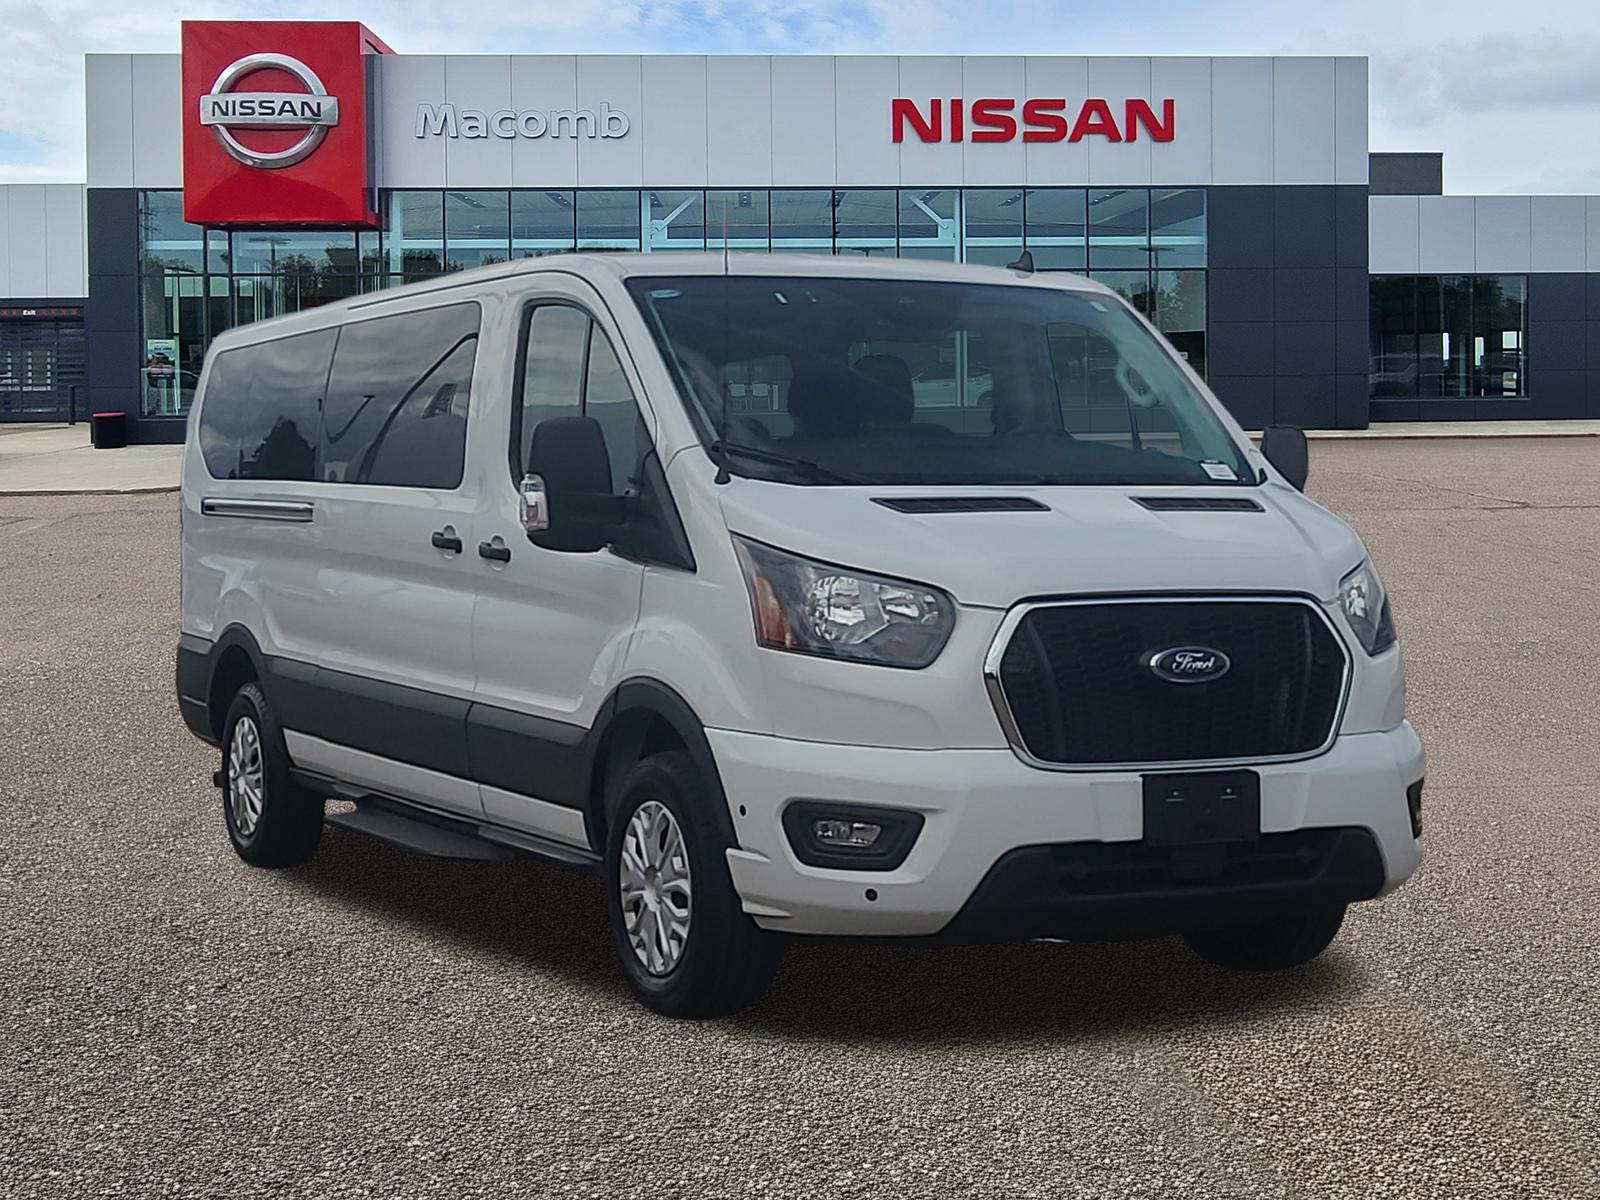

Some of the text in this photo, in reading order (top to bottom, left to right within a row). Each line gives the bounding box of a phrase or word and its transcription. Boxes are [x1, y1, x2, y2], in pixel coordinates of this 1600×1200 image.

[211, 99, 321, 117] NISSAN
[415, 102, 630, 139] Macomb
[892, 98, 1175, 142] NISSAN
[1172, 651, 1215, 671] Ford
